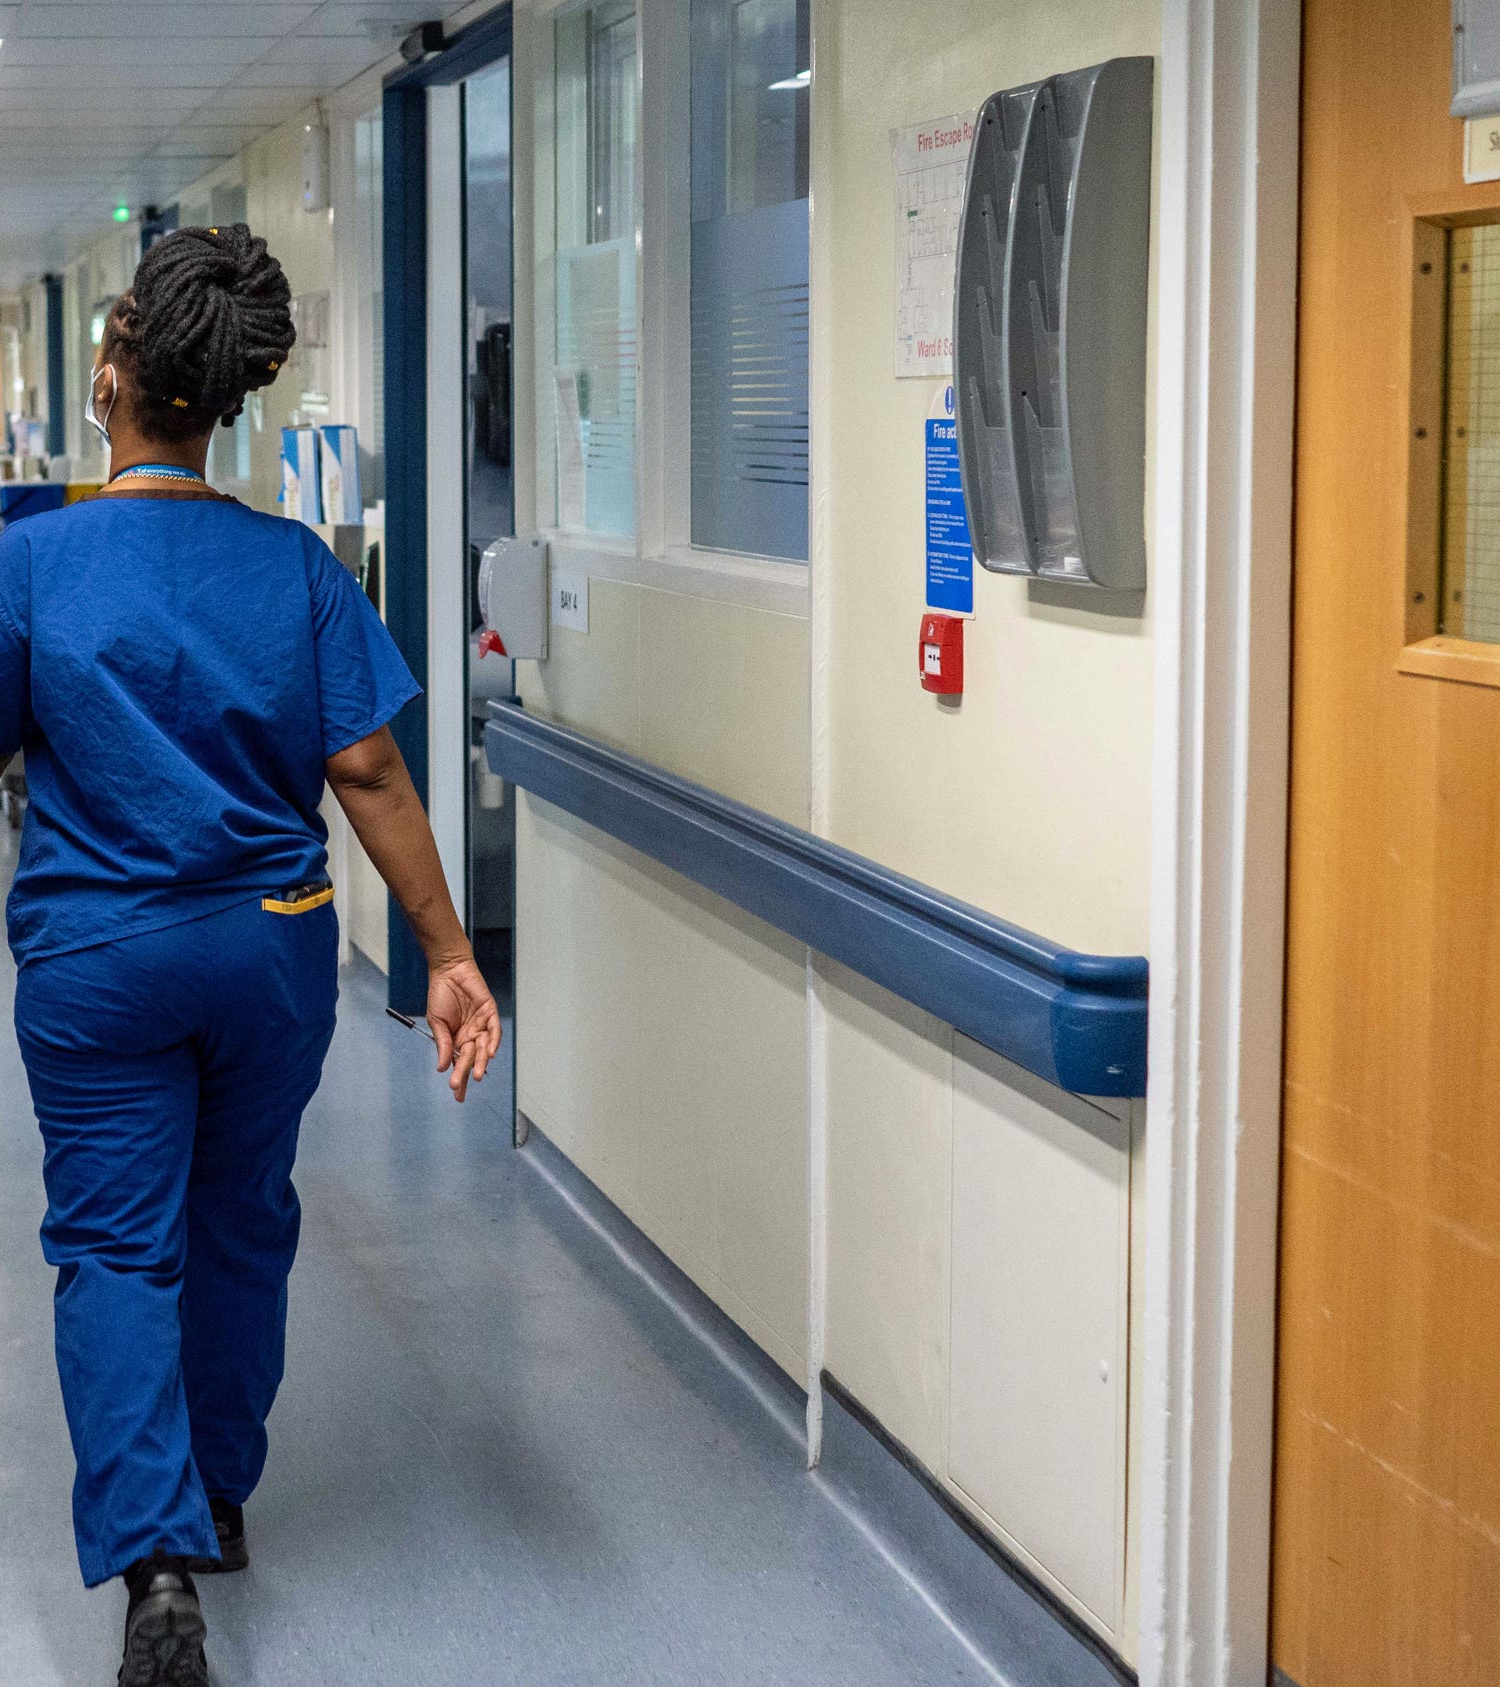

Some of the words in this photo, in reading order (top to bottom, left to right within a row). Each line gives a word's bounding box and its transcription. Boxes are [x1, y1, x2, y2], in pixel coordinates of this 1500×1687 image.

[918, 134, 932, 152] Fire
[934, 128, 961, 149] Escape
[917, 339, 936, 358] Ward
[933, 423, 946, 439] Fire
[560, 590, 571, 610] BAY
